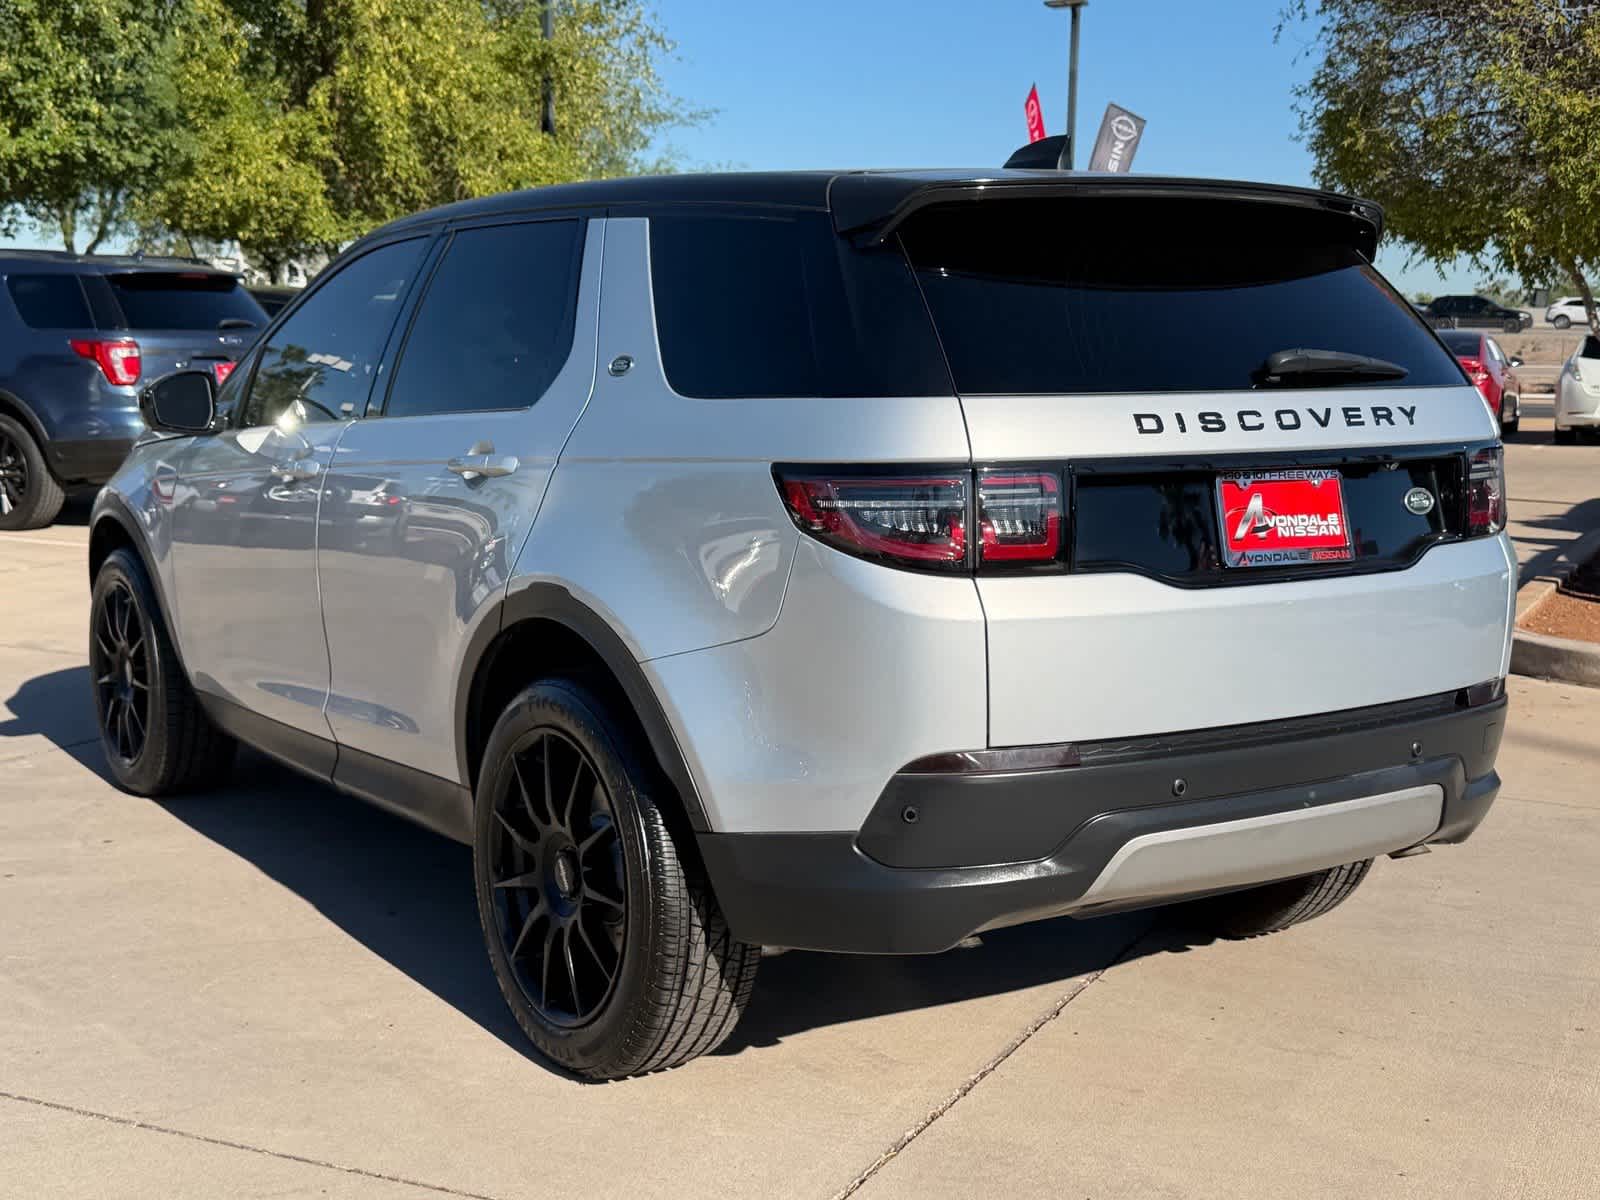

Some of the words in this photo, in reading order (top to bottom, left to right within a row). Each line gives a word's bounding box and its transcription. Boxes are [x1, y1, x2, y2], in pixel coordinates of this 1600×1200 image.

[1132, 406, 1417, 435] DISCOVERY
[1269, 469, 1338, 480] FREEWAYS
[1277, 524, 1342, 538] NISSAN
[1237, 551, 1309, 566] AVONDALE
[1311, 549, 1351, 561] NISSAN
